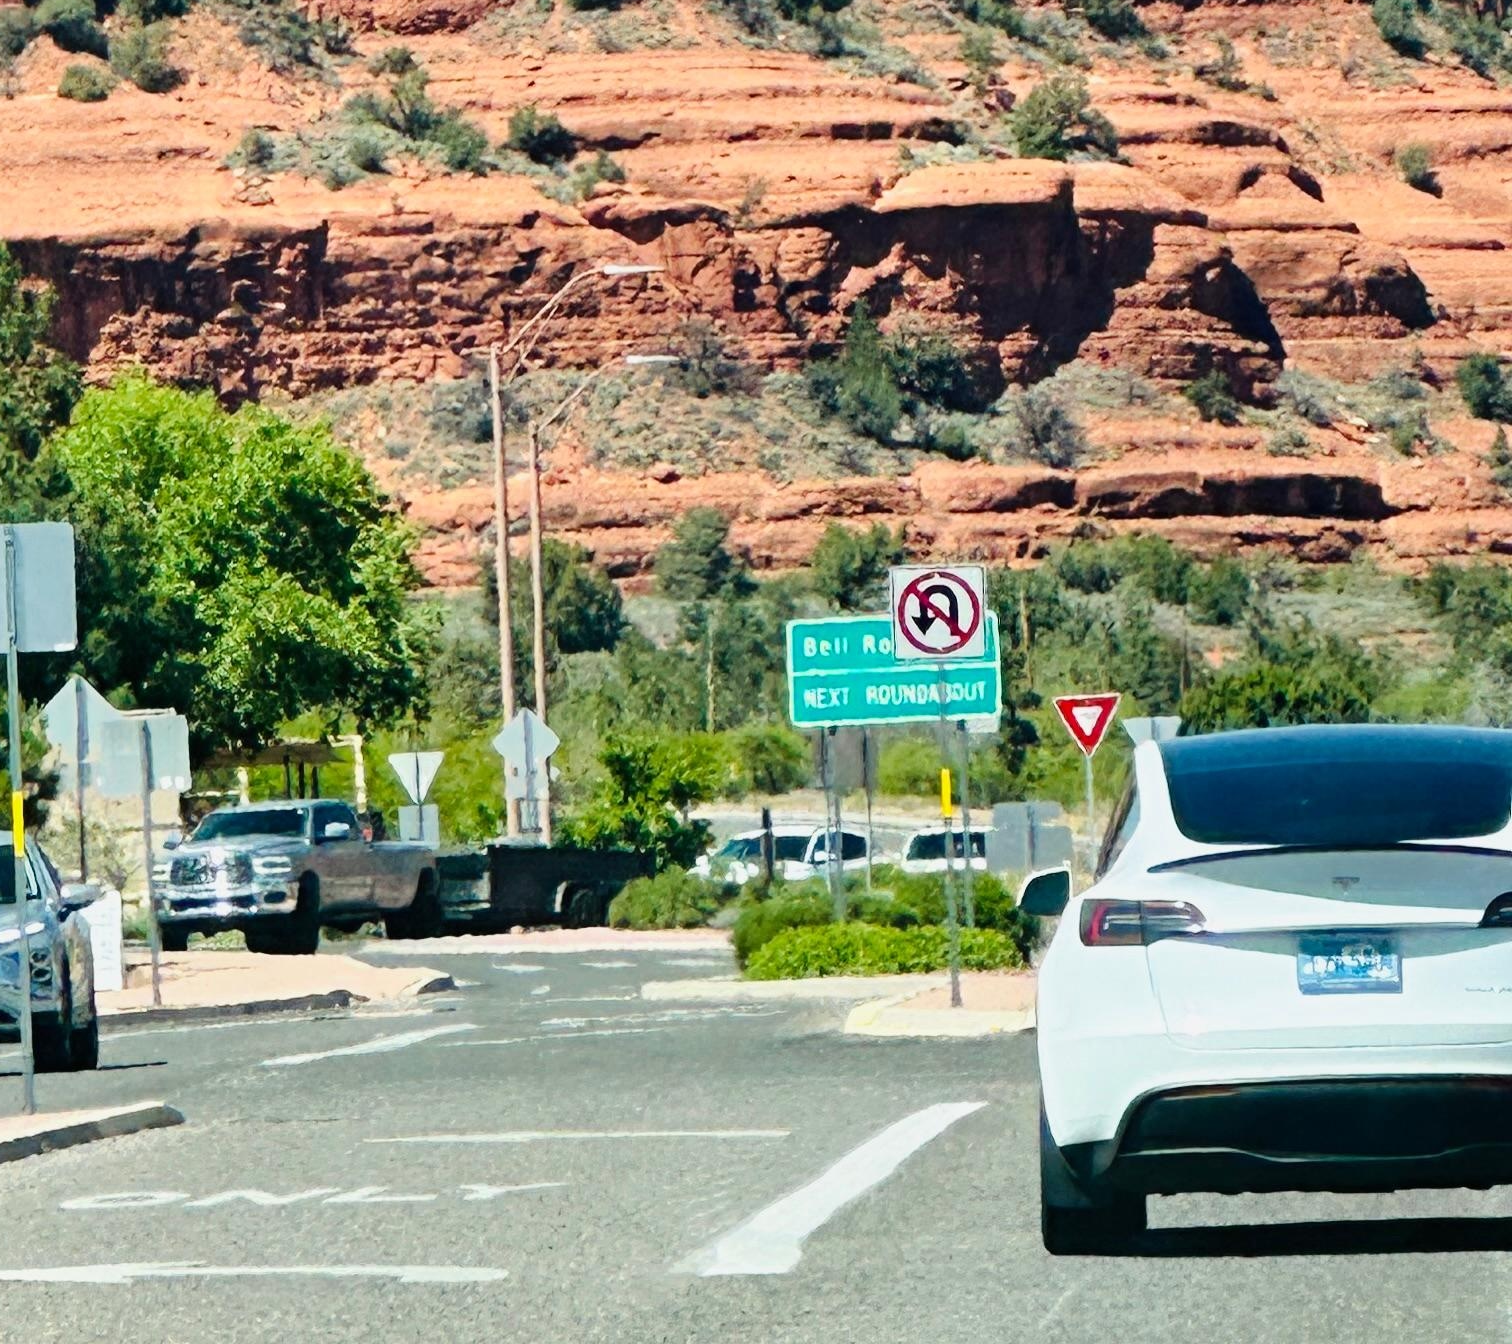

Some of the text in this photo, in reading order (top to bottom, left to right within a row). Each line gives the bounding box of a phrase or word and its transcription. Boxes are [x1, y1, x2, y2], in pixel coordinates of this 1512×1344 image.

[803, 634, 892, 657] Bell Ro
[803, 687, 850, 708] NEXT
[59, 1183, 570, 1210] ONLY
